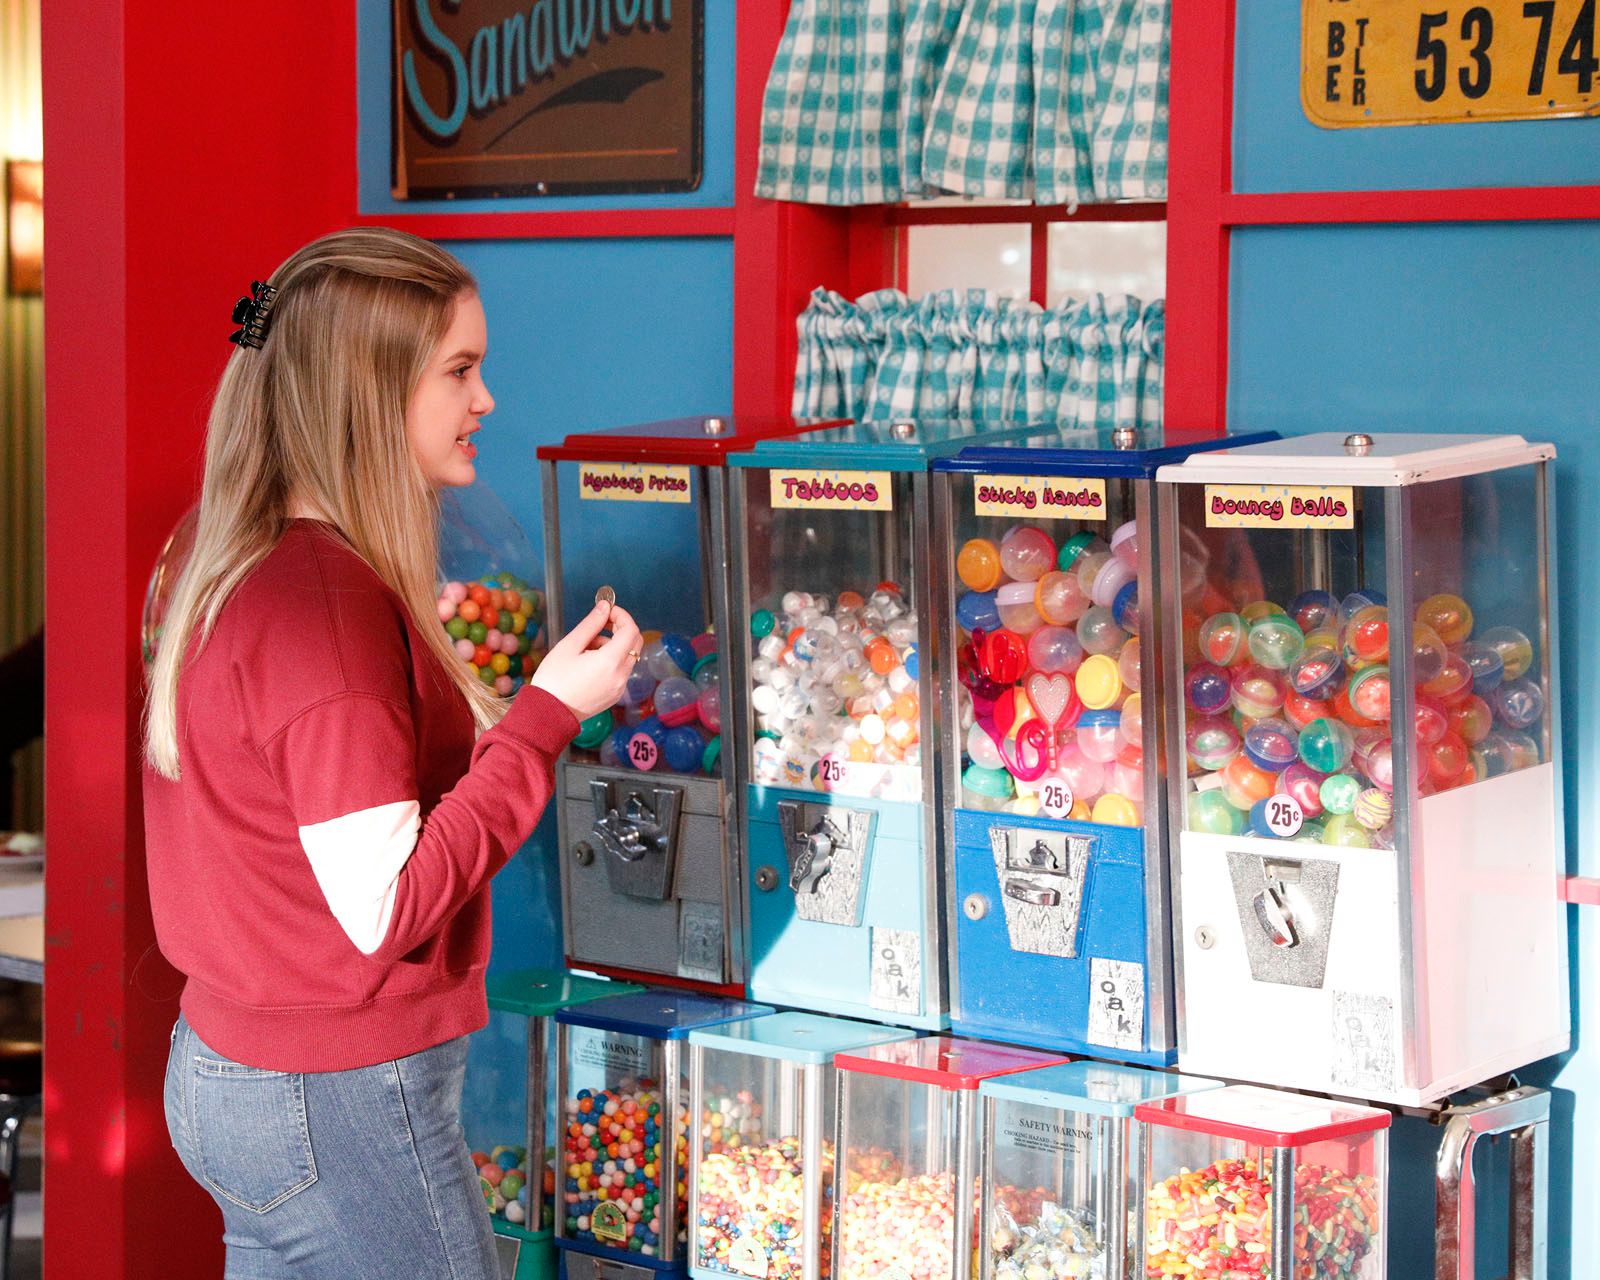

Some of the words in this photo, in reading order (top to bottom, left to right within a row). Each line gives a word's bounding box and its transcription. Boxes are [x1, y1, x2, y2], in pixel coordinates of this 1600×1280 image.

[1414, 7, 1494, 103] 53
[1523, 0, 1599, 96] 74
[403, 0, 671, 137] Sandw
[583, 472, 644, 494] Mystery
[649, 473, 688, 492] Prize
[782, 478, 879, 502] Tattoos
[977, 486, 1038, 509] Sticky
[1042, 487, 1102, 507] Hands
[1211, 496, 1284, 521] Bouncy
[1291, 497, 1348, 517] Balls
[881, 948, 910, 999] oak
[1100, 980, 1132, 1034] oak
[601, 1041, 642, 1058] WARNING
[1018, 1118, 1052, 1133] SAFETY
[1052, 1124, 1093, 1141] WARNING
